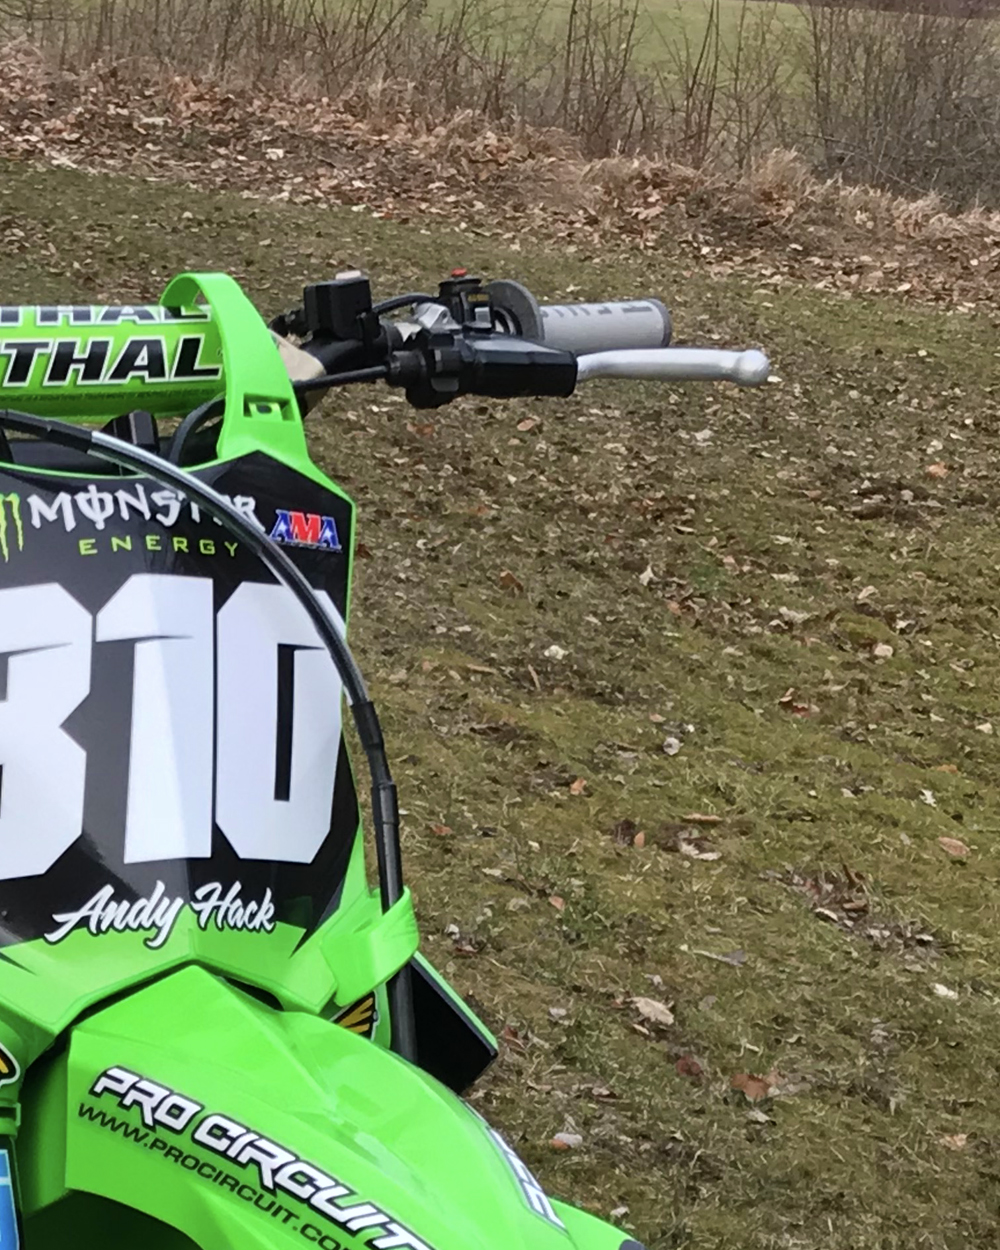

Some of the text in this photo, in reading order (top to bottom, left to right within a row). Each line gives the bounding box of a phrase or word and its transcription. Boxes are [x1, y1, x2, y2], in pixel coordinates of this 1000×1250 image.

[27, 483, 266, 532] MONSR
[269, 508, 343, 550] AMA
[79, 535, 238, 557] ENERGY
[44, 880, 277, 948] Andy Hack
[90, 1065, 203, 1136] PRO
